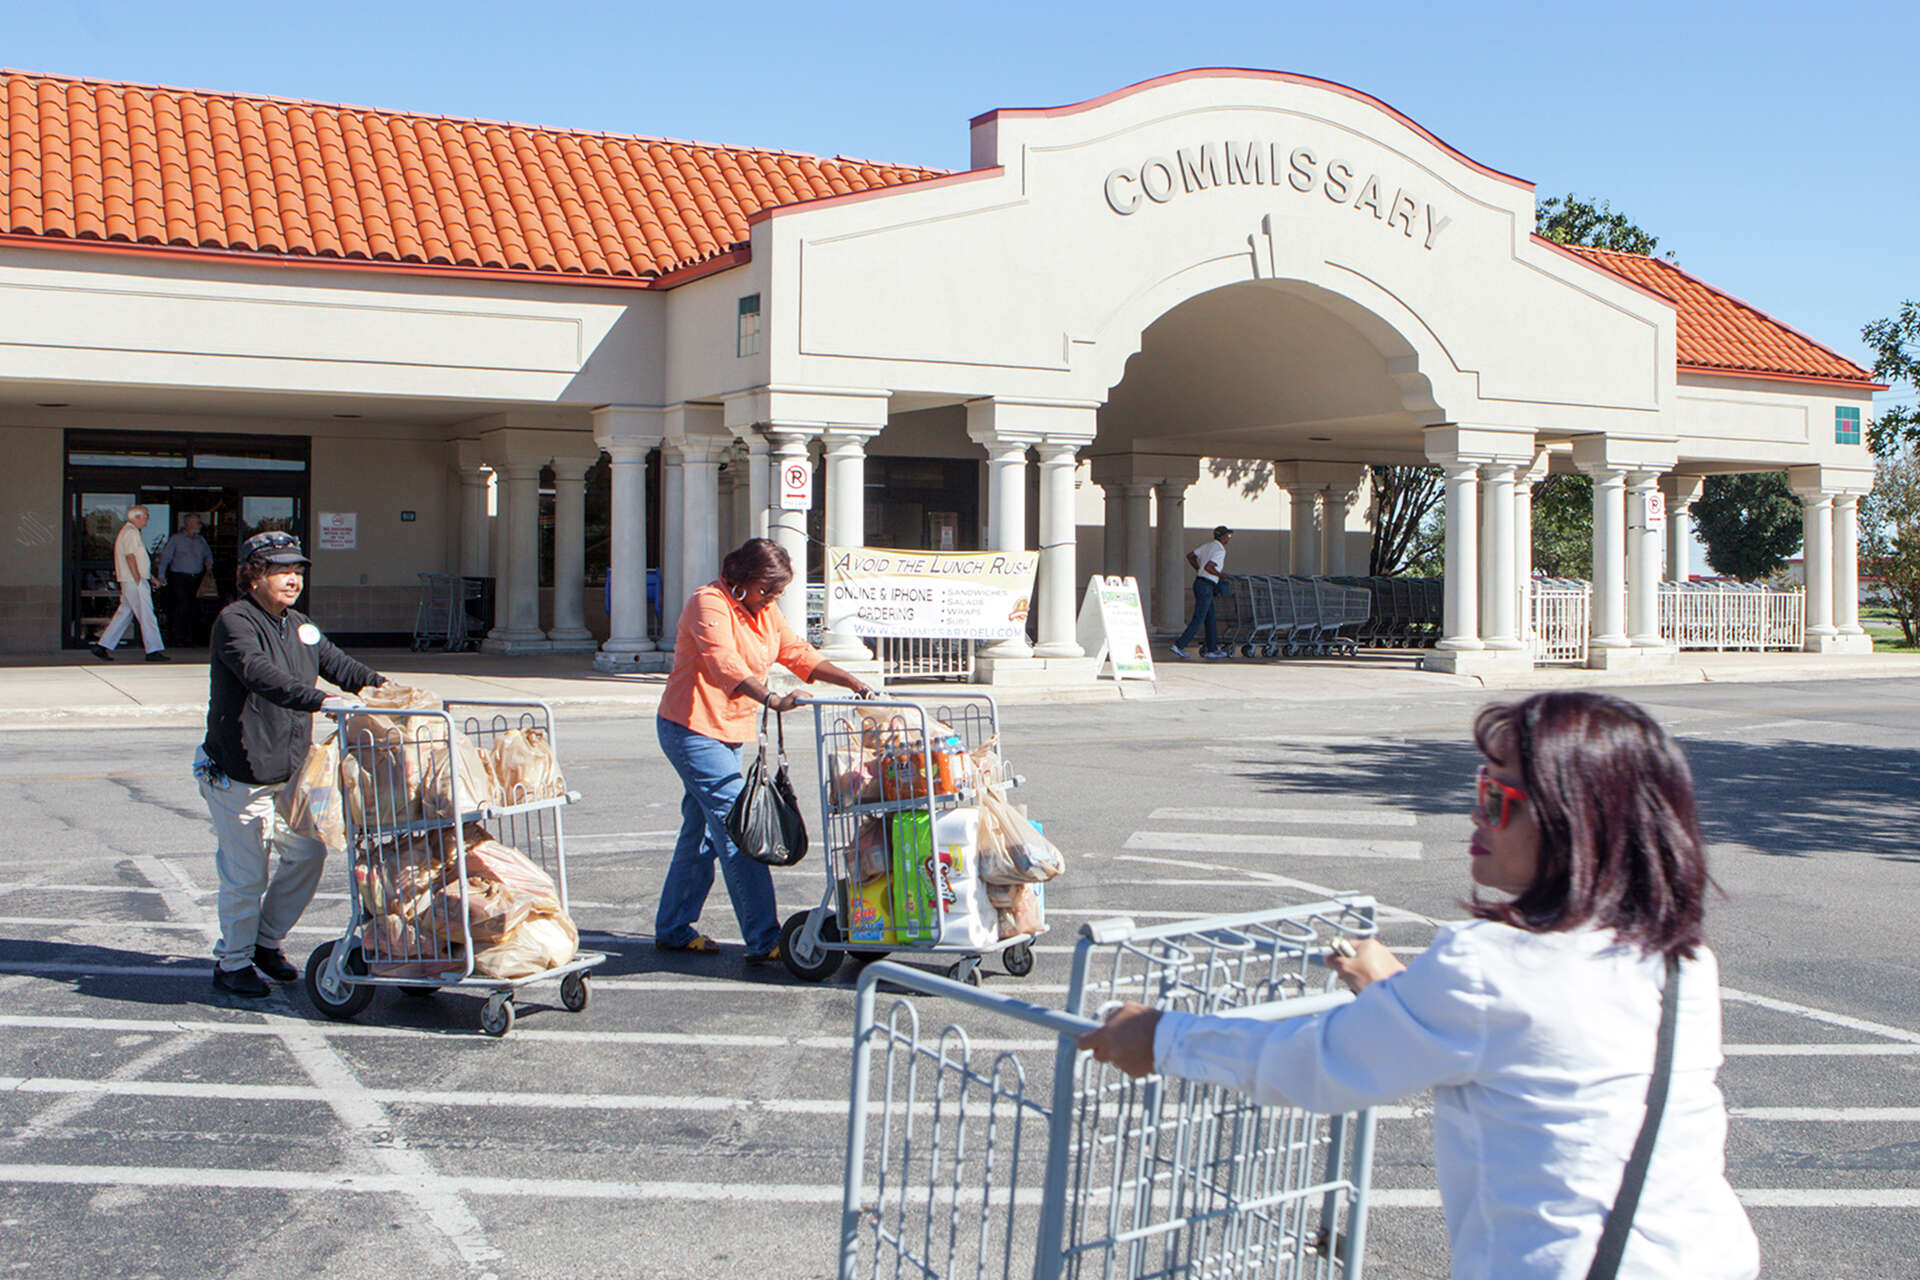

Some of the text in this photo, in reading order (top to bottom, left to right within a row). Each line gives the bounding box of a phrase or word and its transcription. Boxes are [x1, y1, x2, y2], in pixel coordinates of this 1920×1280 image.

[1104, 140, 1453, 250] COMMISSARY
[834, 552, 890, 572] AVOID
[896, 559, 926, 573] THE
[929, 554, 984, 575] LUNCH
[834, 586, 933, 602] ONLINE & IPHONE
[857, 606, 914, 621] ORDERING
[946, 607, 982, 616] WRAPS
